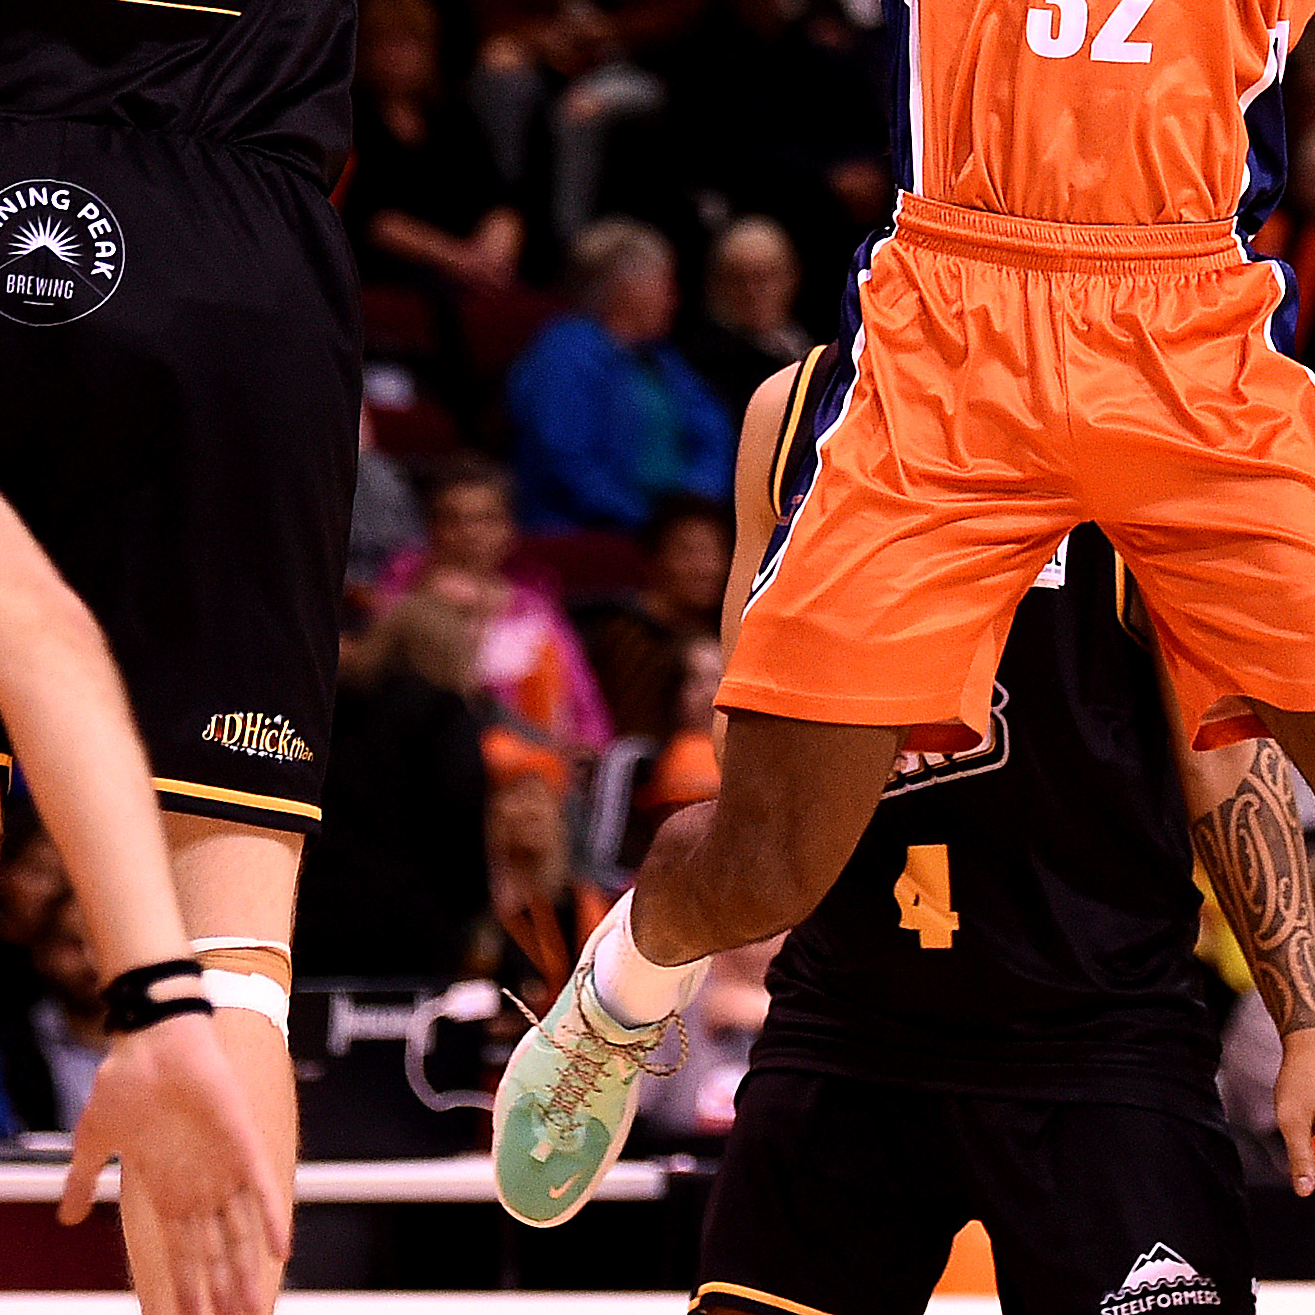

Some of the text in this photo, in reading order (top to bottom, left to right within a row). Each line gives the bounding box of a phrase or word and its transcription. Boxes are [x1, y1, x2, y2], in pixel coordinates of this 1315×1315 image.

[76, 201, 117, 280] PEAK
[6, 273, 75, 300] BREWING
[893, 844, 959, 949] 4
